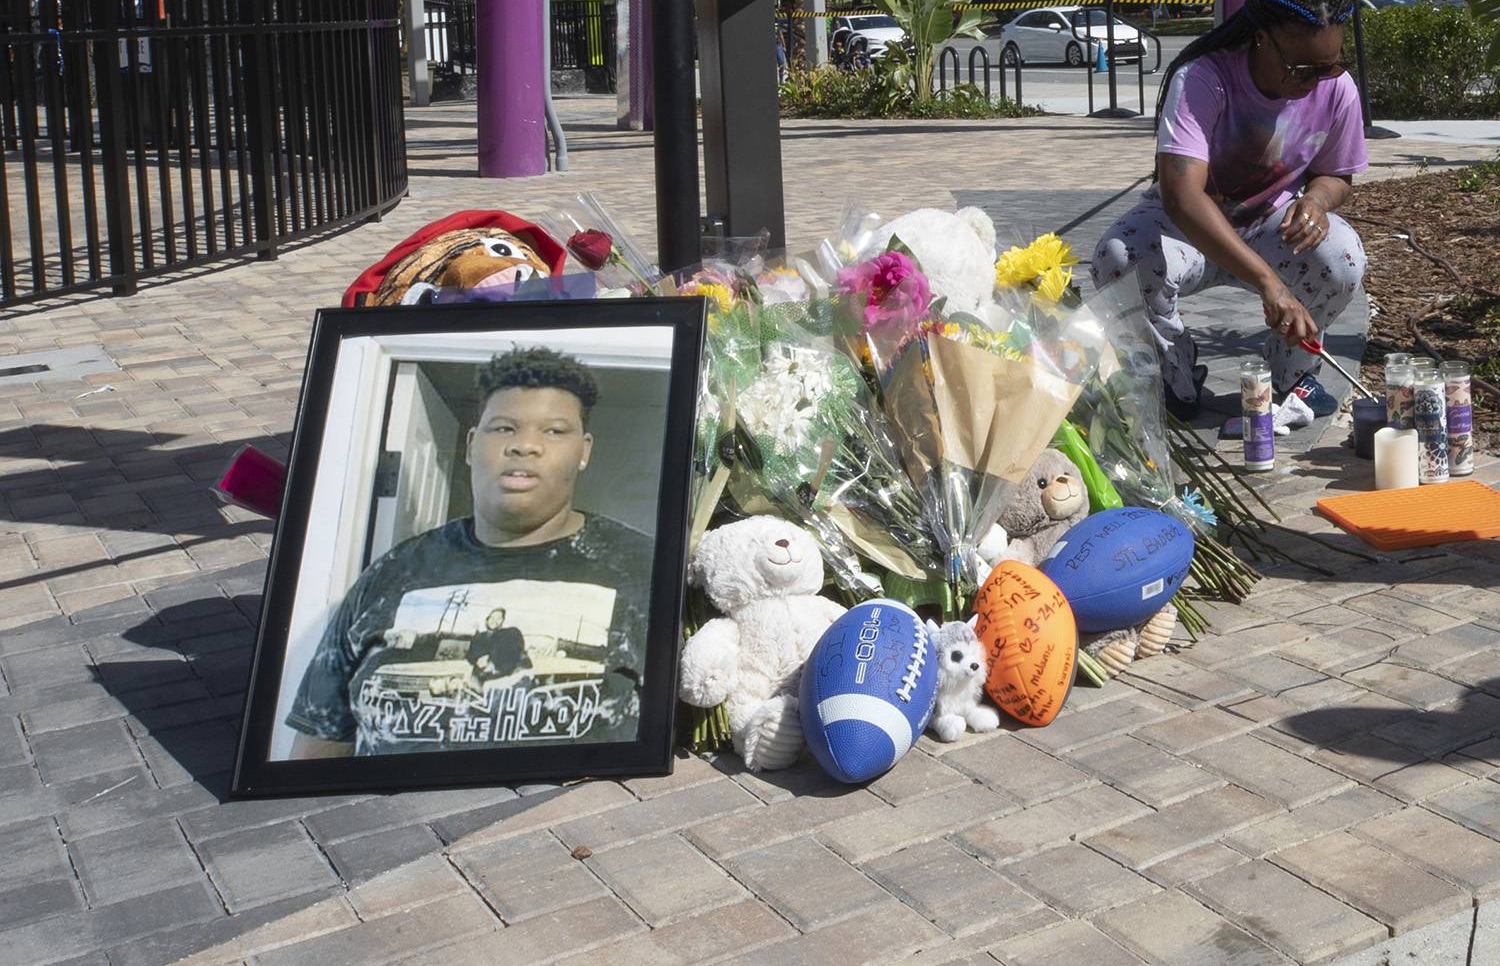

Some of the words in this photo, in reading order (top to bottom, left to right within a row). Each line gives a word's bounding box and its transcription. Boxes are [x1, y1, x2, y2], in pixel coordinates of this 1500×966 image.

[1003, 591, 1026, 609] in
[984, 636, 1008, 684] eace
[449, 716, 493, 743] THE
[494, 678, 601, 742] HOOD
